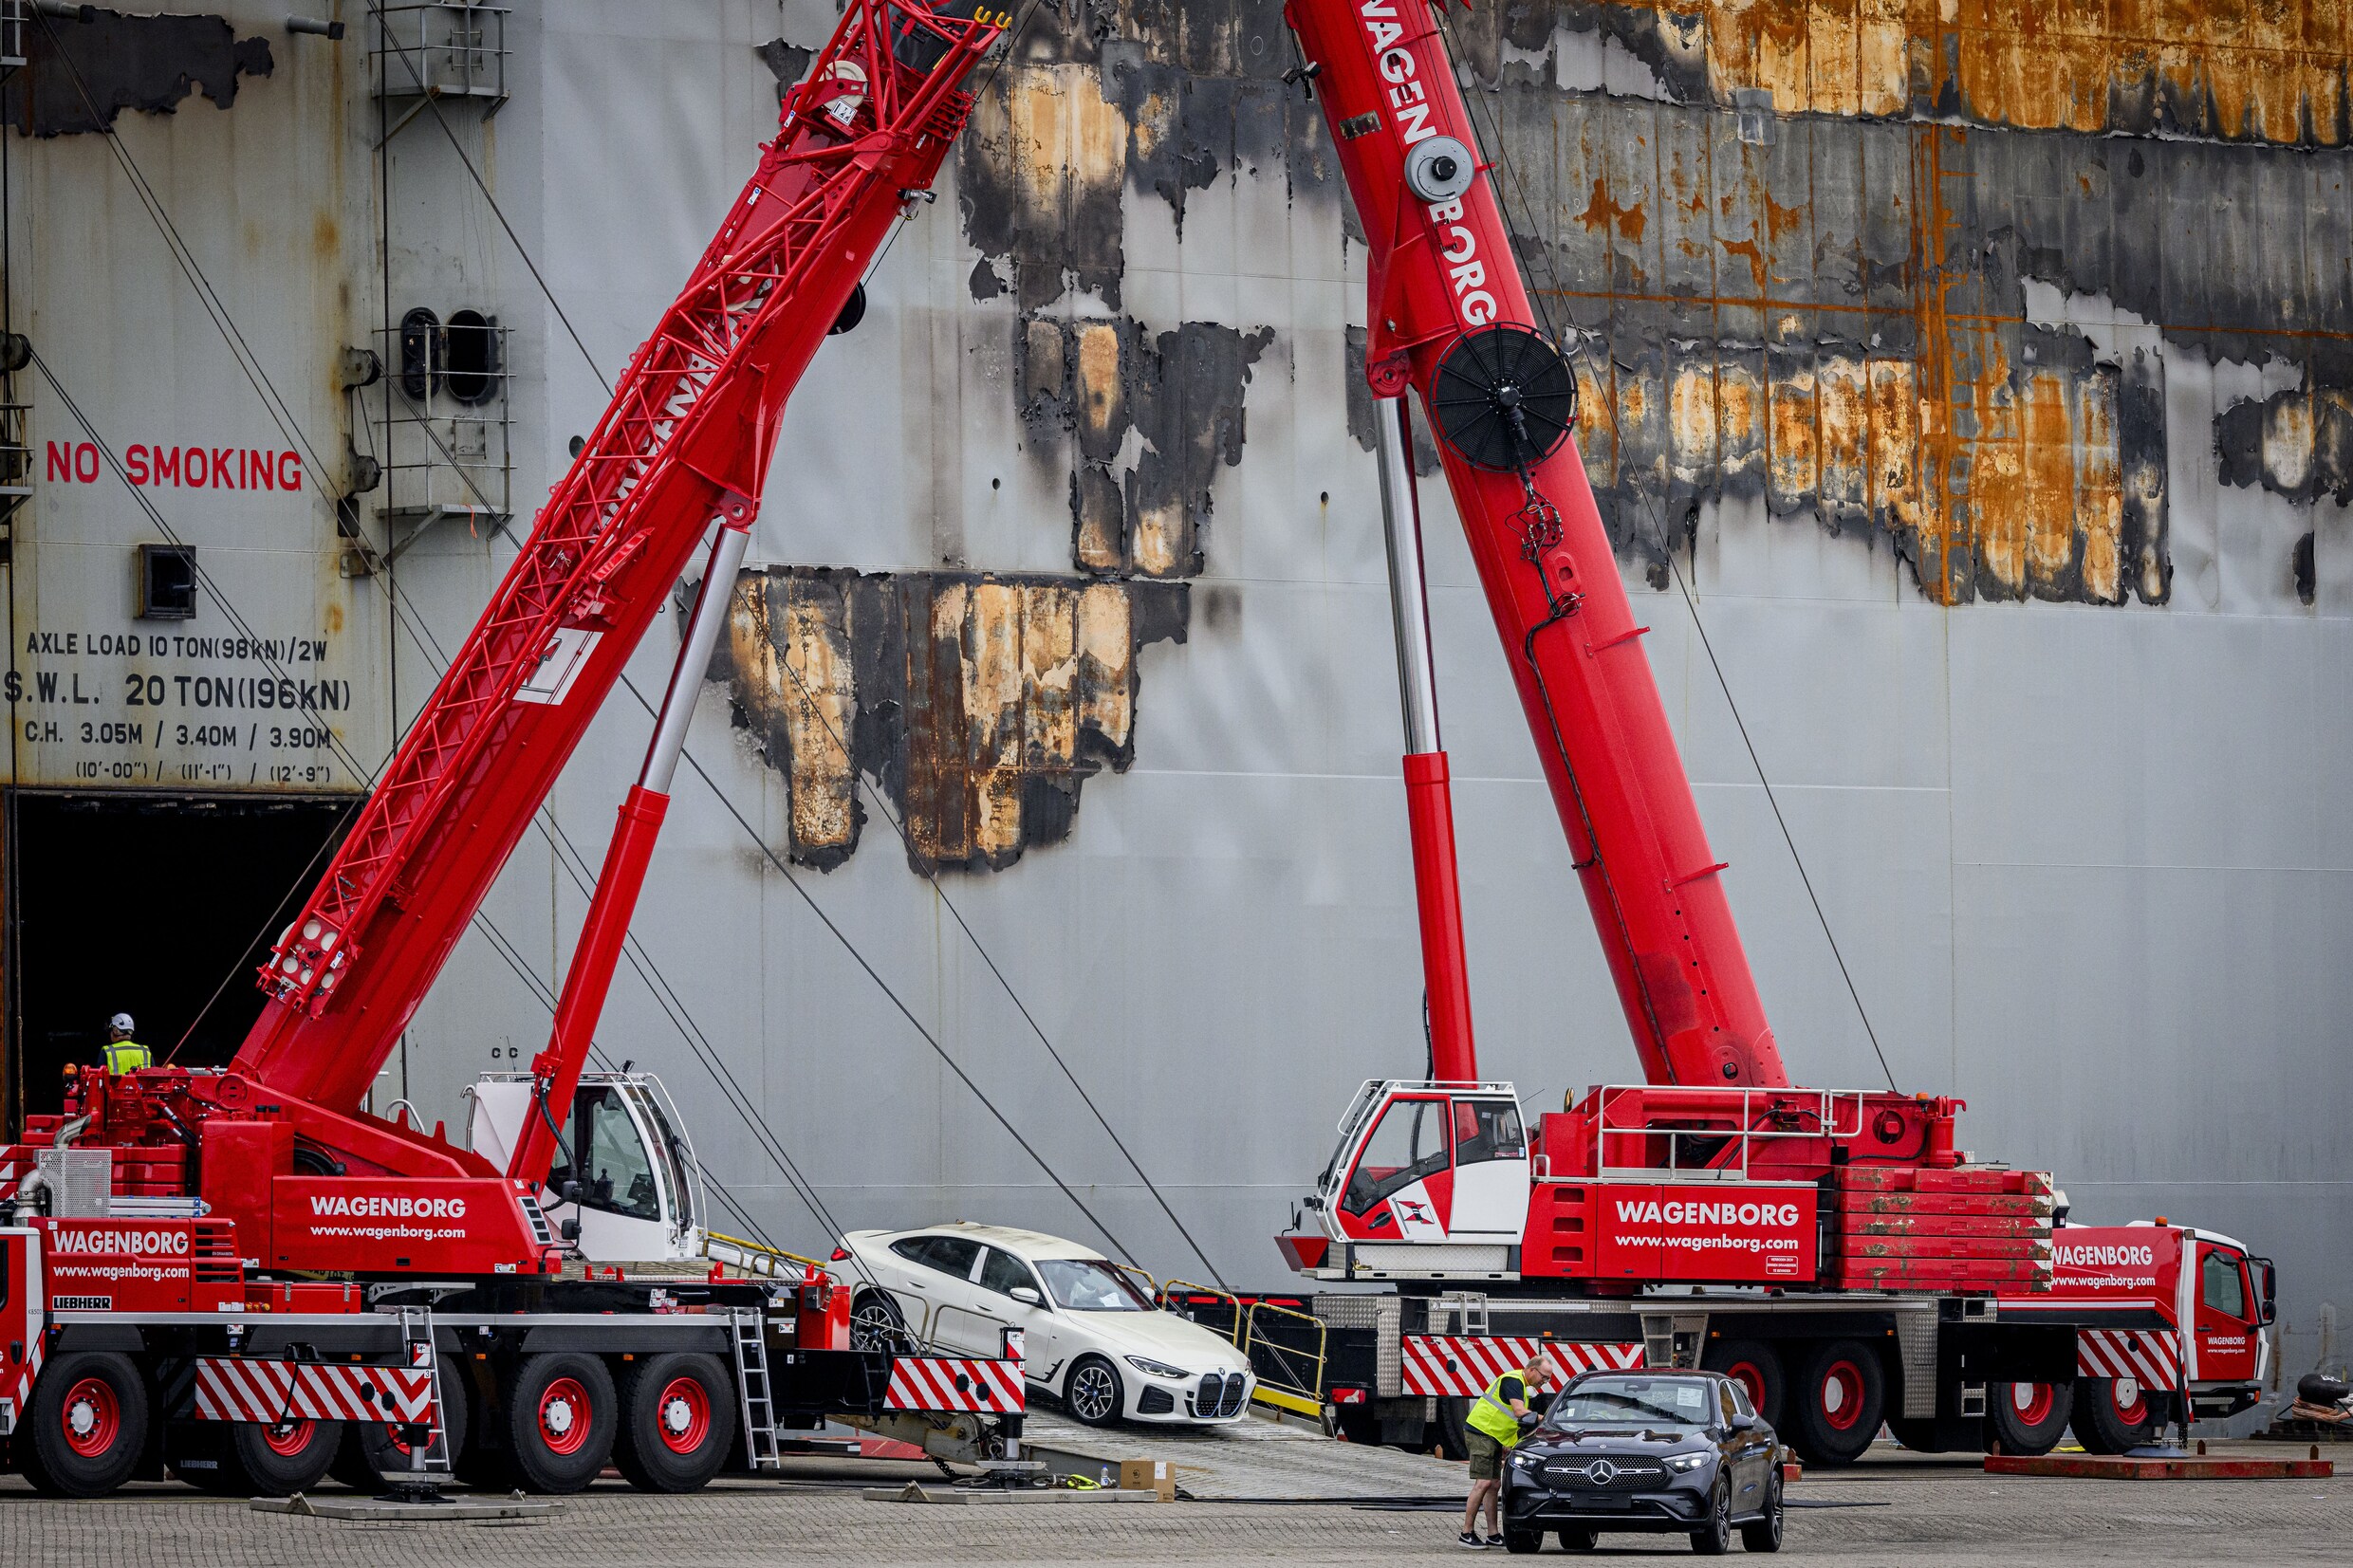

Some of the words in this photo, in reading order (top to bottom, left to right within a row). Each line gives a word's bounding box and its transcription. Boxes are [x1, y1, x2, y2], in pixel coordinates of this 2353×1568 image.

[47, 440, 100, 484] NO
[126, 443, 302, 491] SMOKING
[27, 632, 78, 655] AXLE
[86, 634, 140, 656] LOAD
[149, 635, 167, 657] 10
[4, 671, 100, 705] S.W.L.
[125, 673, 165, 707] 20
[25, 721, 64, 744] C.H.
[81, 722, 142, 745] 3.05M
[155, 720, 163, 748] /
[176, 724, 237, 747] 3.40M
[249, 723, 257, 751] /
[269, 727, 331, 749] 3.90M
[157, 761, 163, 782] /
[250, 763, 256, 784] /
[310, 1196, 466, 1219] WAGENBORG
[1615, 1200, 1799, 1227] WAGENBORG
[52, 1230, 189, 1254] WAGENBORG
[310, 1224, 466, 1241] www.wagenborg.com
[1615, 1233, 1799, 1253] www.wagenborg.com
[53, 1262, 190, 1282] www.wagenborg.com
[2051, 1273, 2156, 1289] www.wagenborg.com
[53, 1297, 111, 1309] LIEBHERR
[2207, 1337, 2246, 1345] WAGENBORG
[180, 1460, 218, 1469] LIEBHERR
